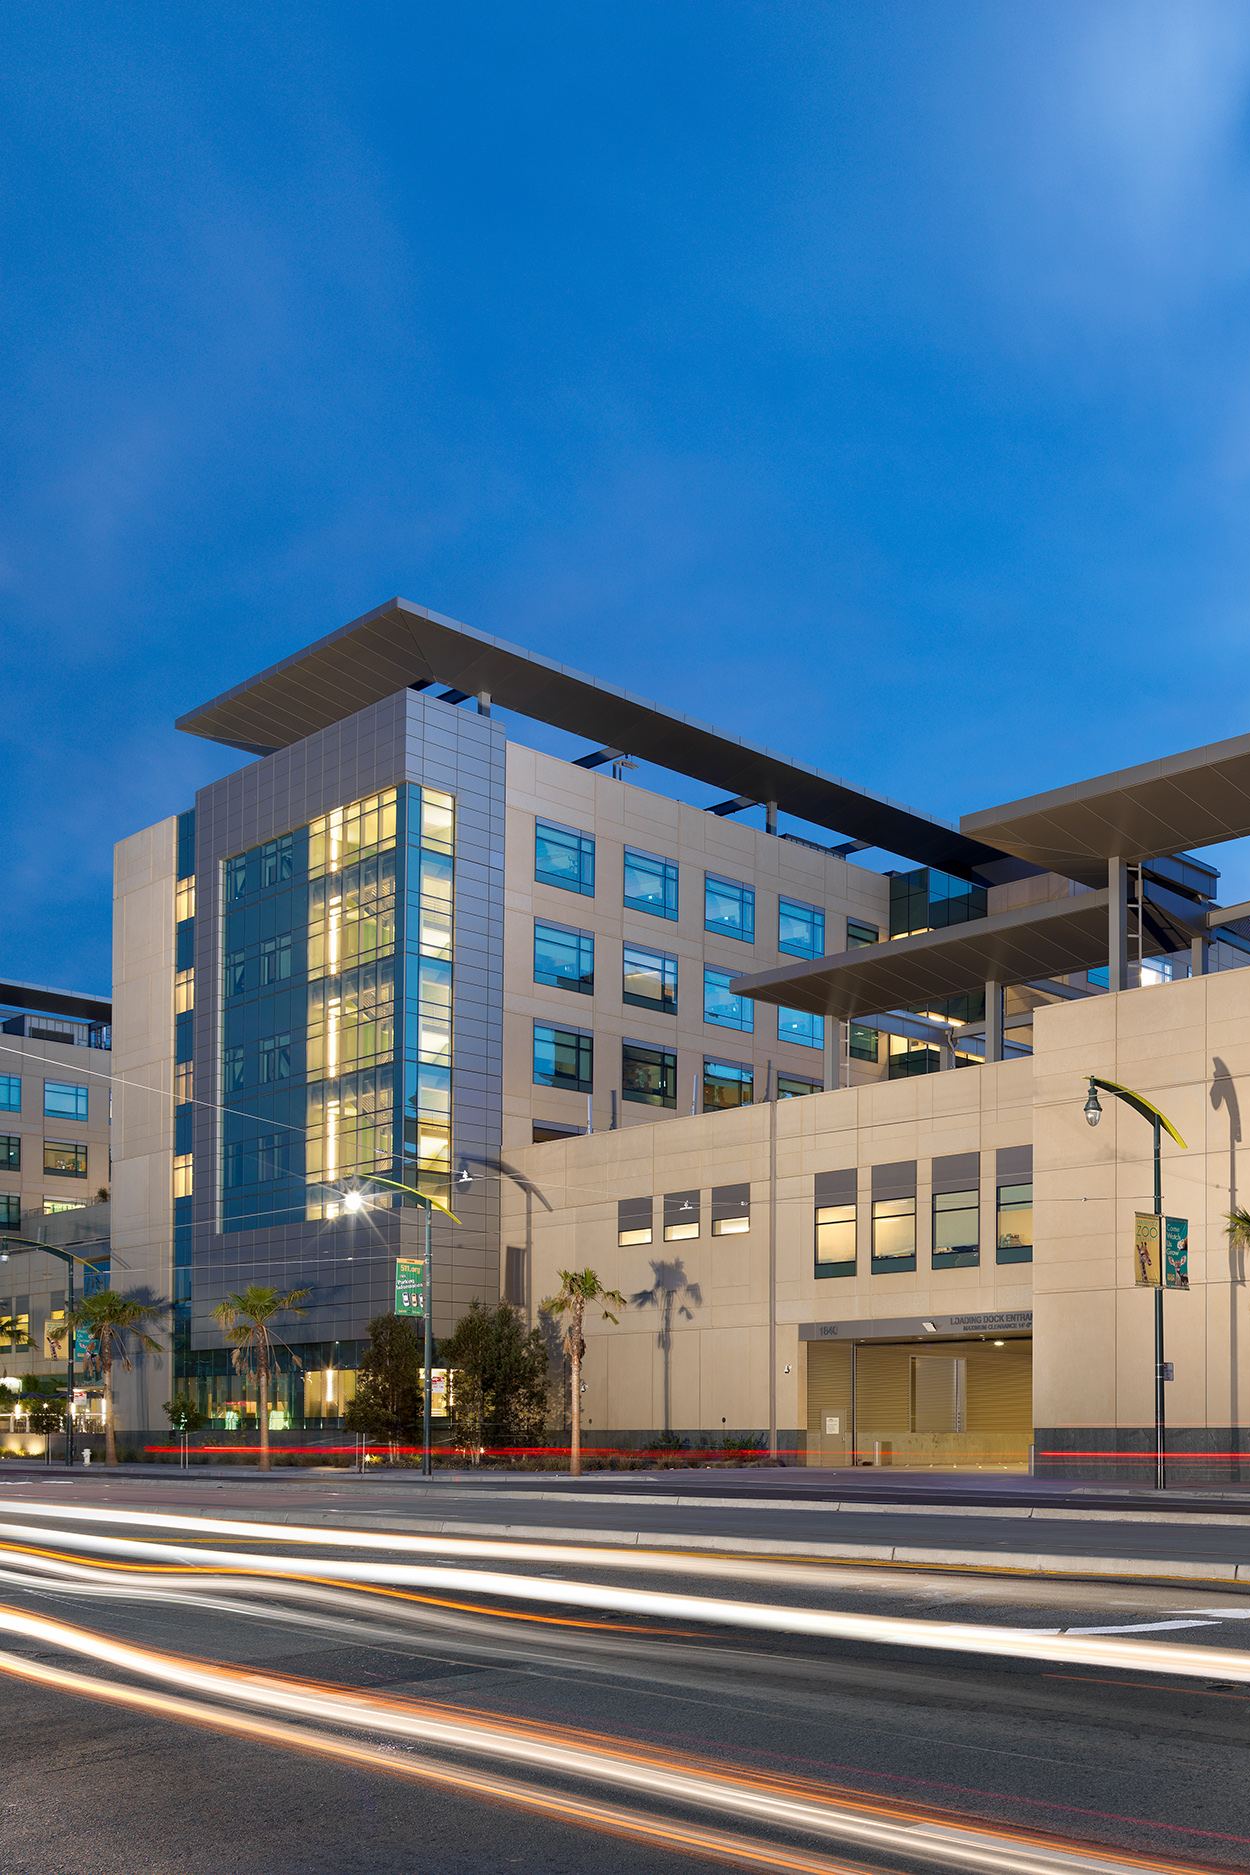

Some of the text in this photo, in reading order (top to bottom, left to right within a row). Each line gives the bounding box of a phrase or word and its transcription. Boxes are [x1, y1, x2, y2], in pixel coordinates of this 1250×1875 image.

[1136, 1226, 1158, 1238] ZOO
[1166, 1224, 1180, 1232] Come
[401, 1265, 420, 1274] 511.org
[950, 1316, 982, 1325] LOADING
[983, 1315, 1004, 1323] DOCK
[820, 1326, 838, 1336] 1840
